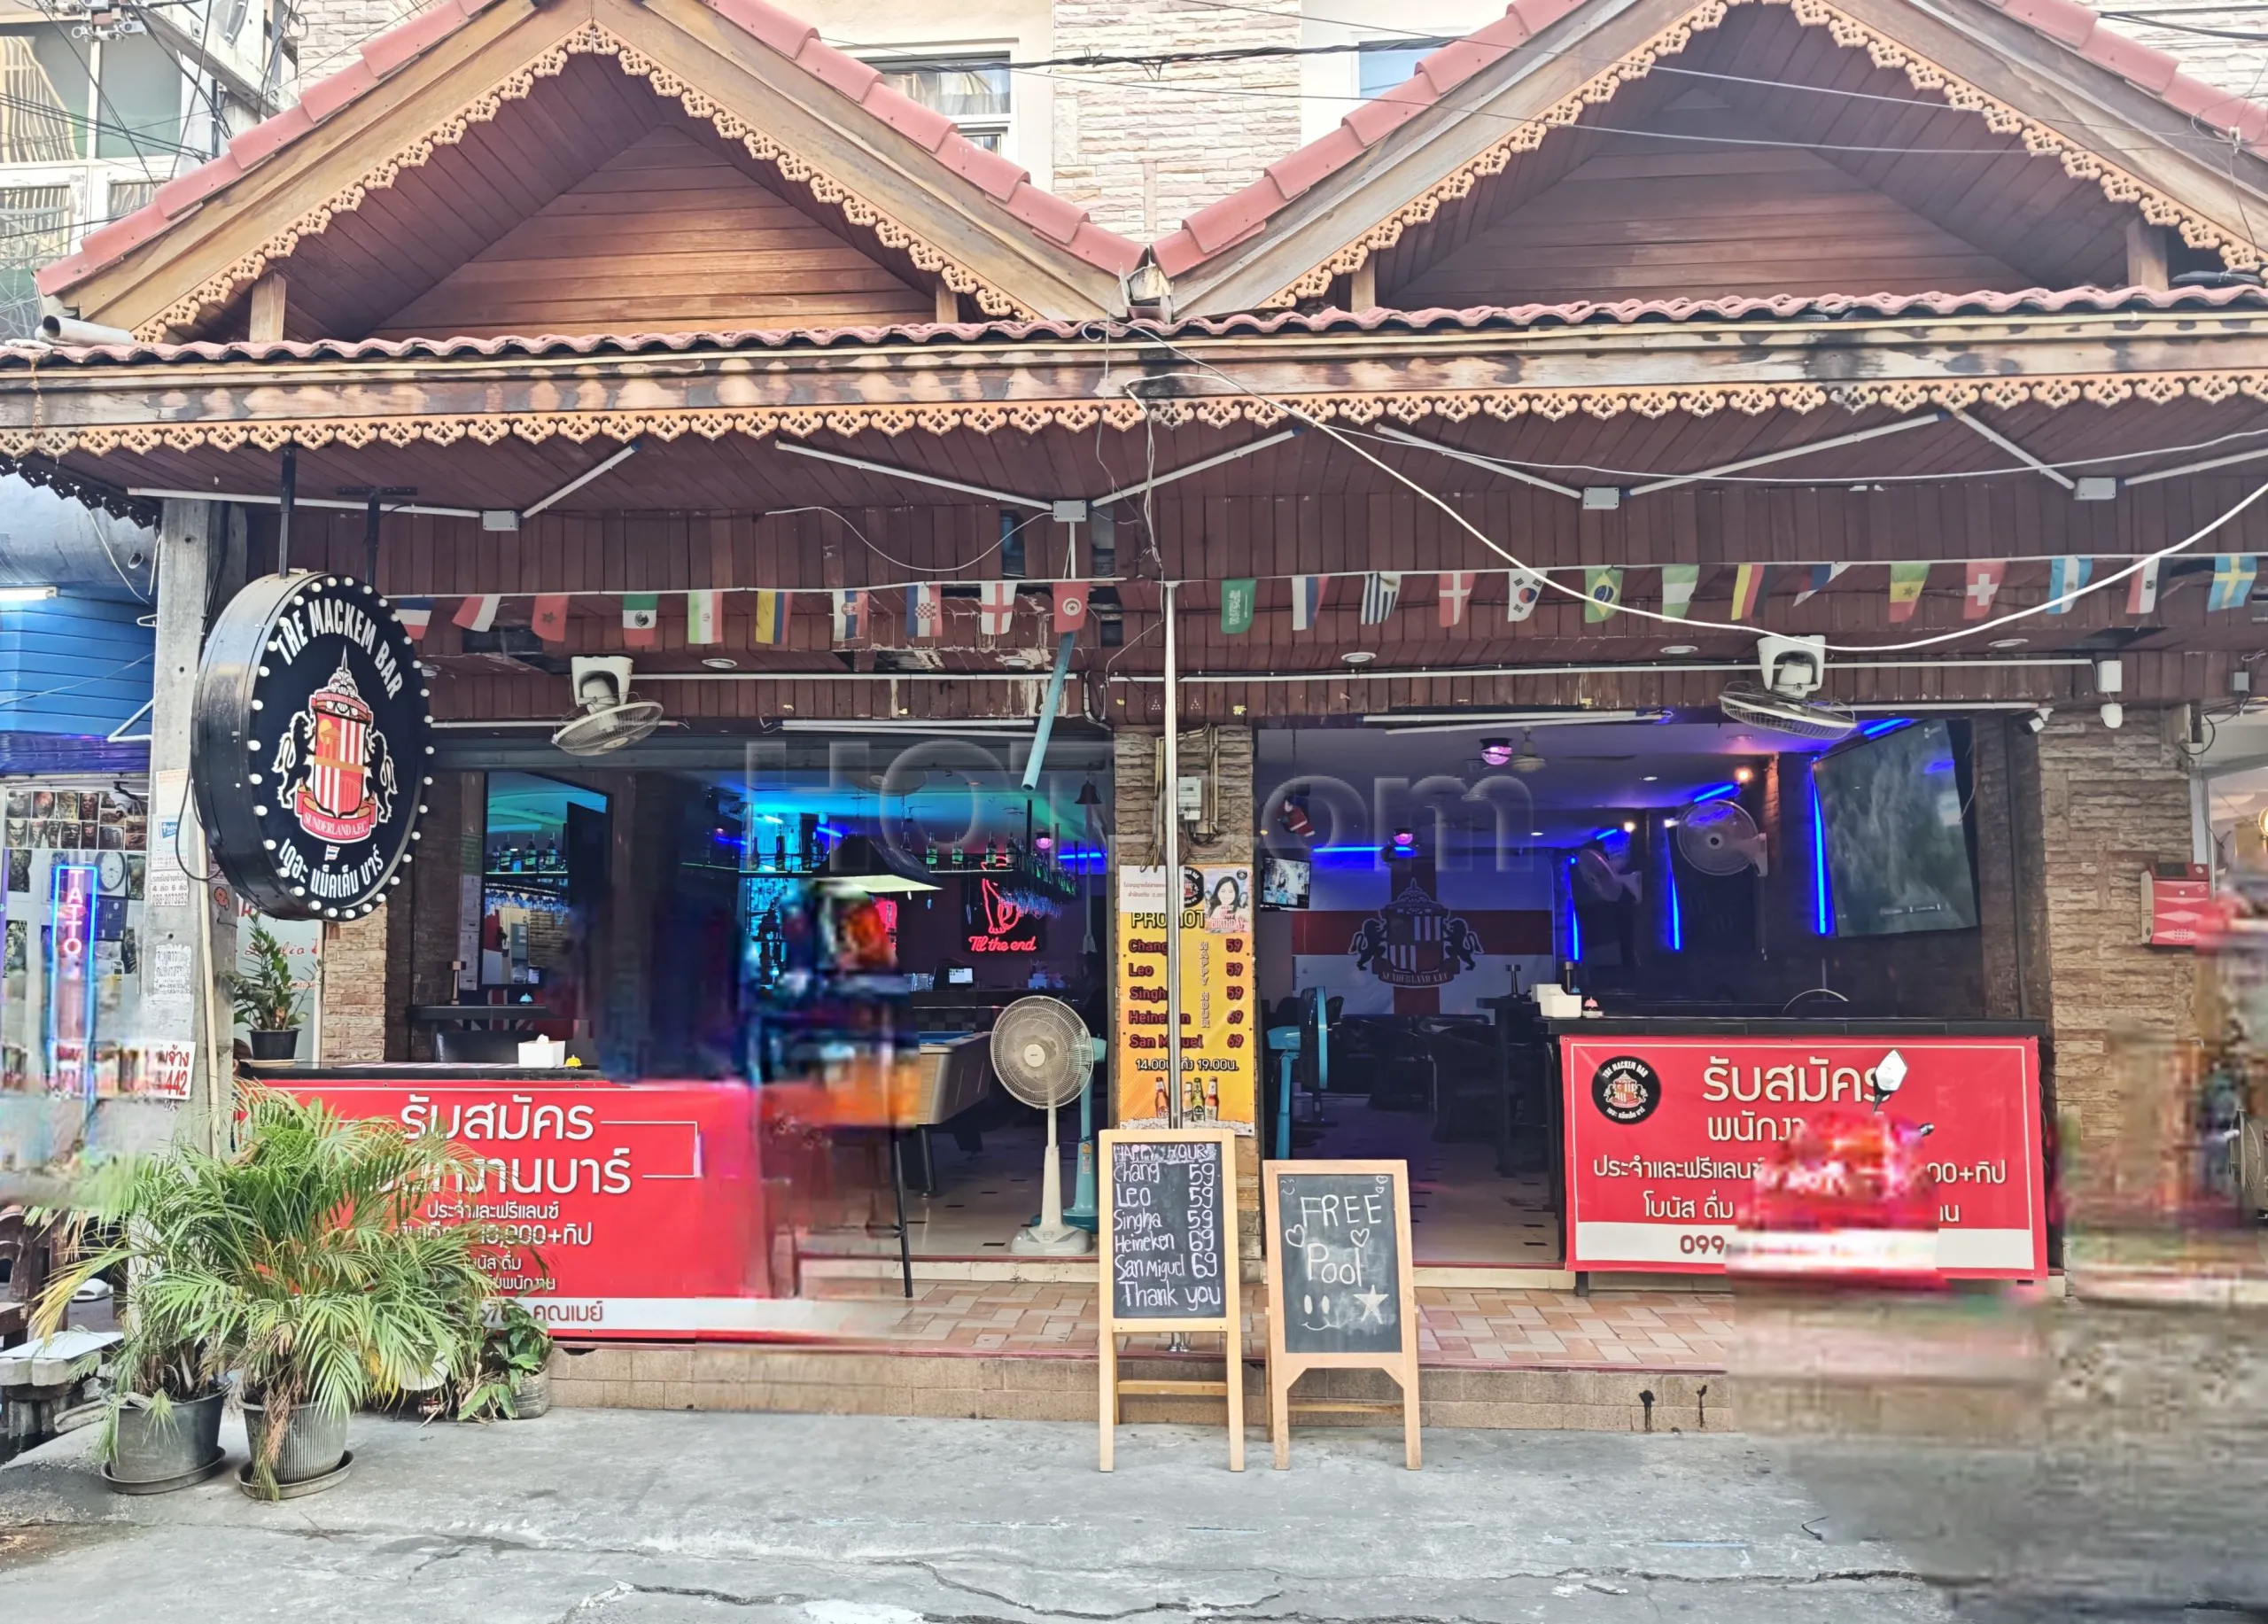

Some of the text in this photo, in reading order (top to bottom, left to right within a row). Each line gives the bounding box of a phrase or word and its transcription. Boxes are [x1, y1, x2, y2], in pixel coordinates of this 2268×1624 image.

[276, 598, 403, 700] THE MACKEM BAR
[303, 812, 352, 836] SUNDERLAND
[361, 843, 384, 885] บาร์
[988, 936, 1009, 952] the
[1010, 936, 1037, 952] end
[1129, 938, 1244, 956] Chang 59
[1129, 962, 1244, 976] Leo 59
[1200, 942, 1209, 985] HAPPY
[1382, 971, 1432, 983] SUNDERLAND
[1130, 986, 1244, 1003] Singh 59
[1129, 1010, 1244, 1024] Heinen 69
[1200, 991, 1210, 1028] HOUR
[1130, 1034, 1244, 1048] San Muel 69
[1198, 1058, 1239, 1071] 19.00น.
[1612, 1061, 1637, 1071] MACKEM
[400, 1093, 594, 1141] รับสมัคร
[1114, 1144, 1207, 1162] HAPPY HOUR
[1114, 1162, 1160, 1184] Chang
[1189, 1162, 1215, 1186] 59
[1116, 1183, 1214, 1208] Leo 59
[1643, 1189, 1734, 1219] โบนัส ดื่ม
[427, 1200, 559, 1220] ประจำและฟรีแลนซ์
[1114, 1208, 1214, 1234] Singha 59
[1300, 1194, 1382, 1227] FREE
[1115, 1229, 1214, 1253] Heineken 69
[501, 1250, 522, 1270] ดื่ม
[1115, 1252, 1217, 1282] San Miguel 69
[1307, 1243, 1363, 1286] Pool
[1119, 1279, 1221, 1311] Thank you
